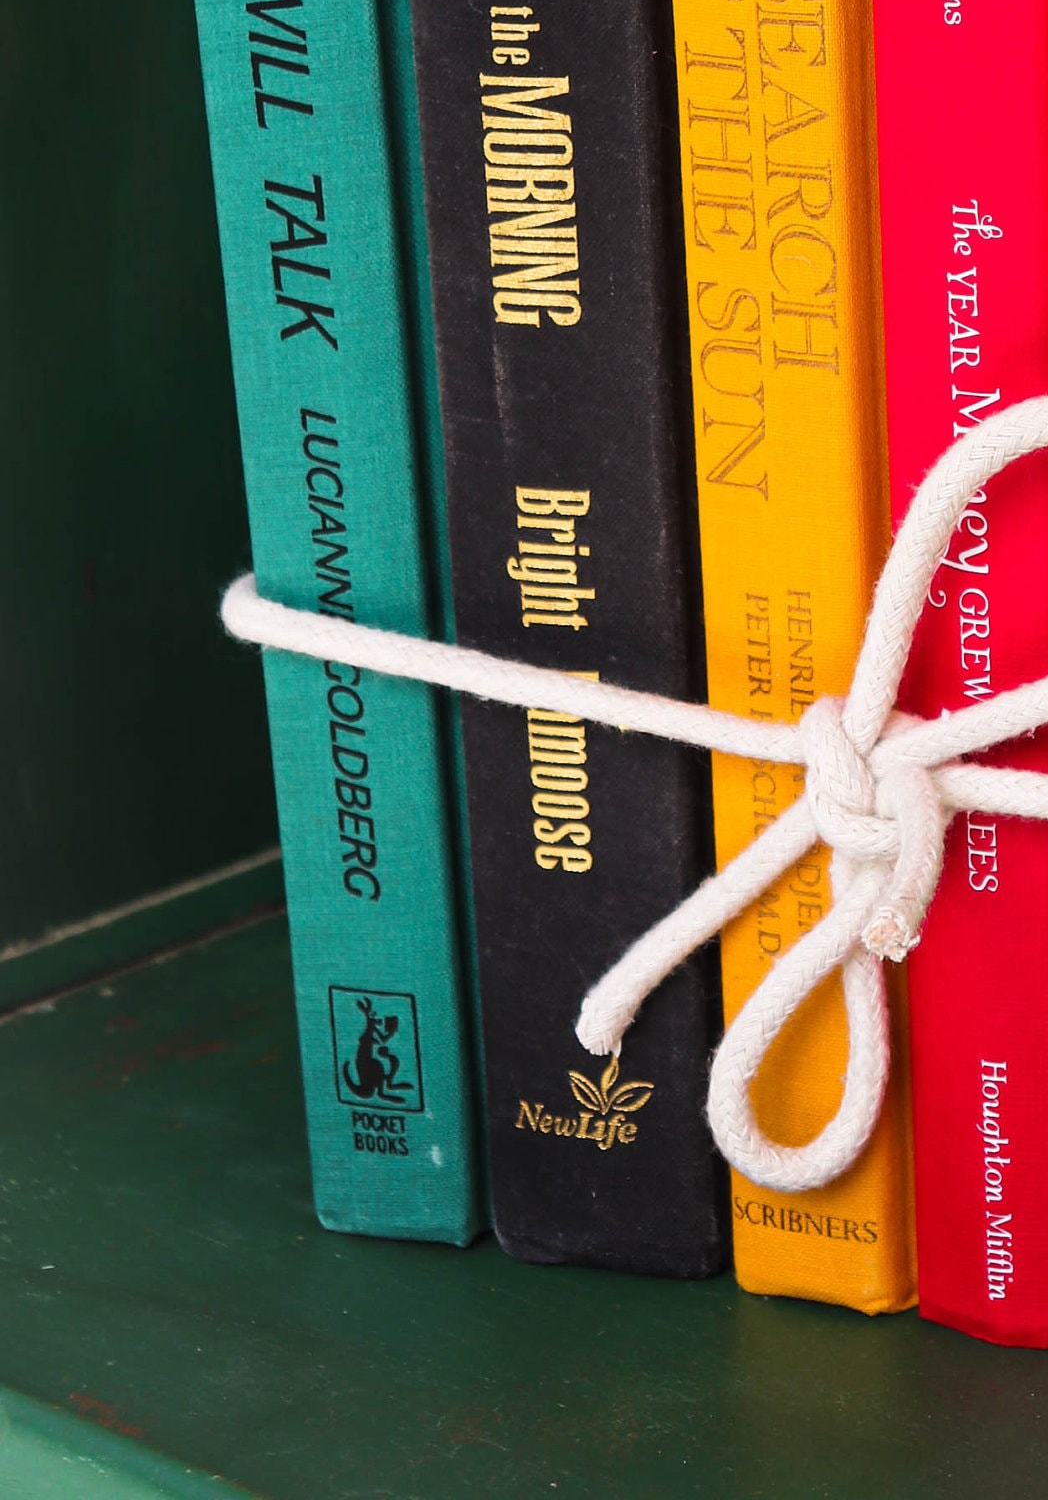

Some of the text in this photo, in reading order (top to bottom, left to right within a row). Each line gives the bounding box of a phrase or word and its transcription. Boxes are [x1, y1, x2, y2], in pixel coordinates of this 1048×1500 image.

[490, 7, 541, 66] the
[478, 72, 582, 329] MORNING
[681, 27, 758, 257] THE
[263, 174, 339, 352] TALK
[952, 198, 1004, 256] The
[946, 266, 981, 374] YEAR
[692, 281, 769, 504] SUN
[299, 406, 356, 624] LUCIANN
[506, 485, 596, 631] Bright
[745, 590, 774, 698] PETER
[350, 1109, 408, 1136] POCKET
[352, 1134, 411, 1158] BOOKS
[977, 1059, 1014, 1301] Houghton Mifflin
[734, 1197, 878, 1244] SCRIBNERS
